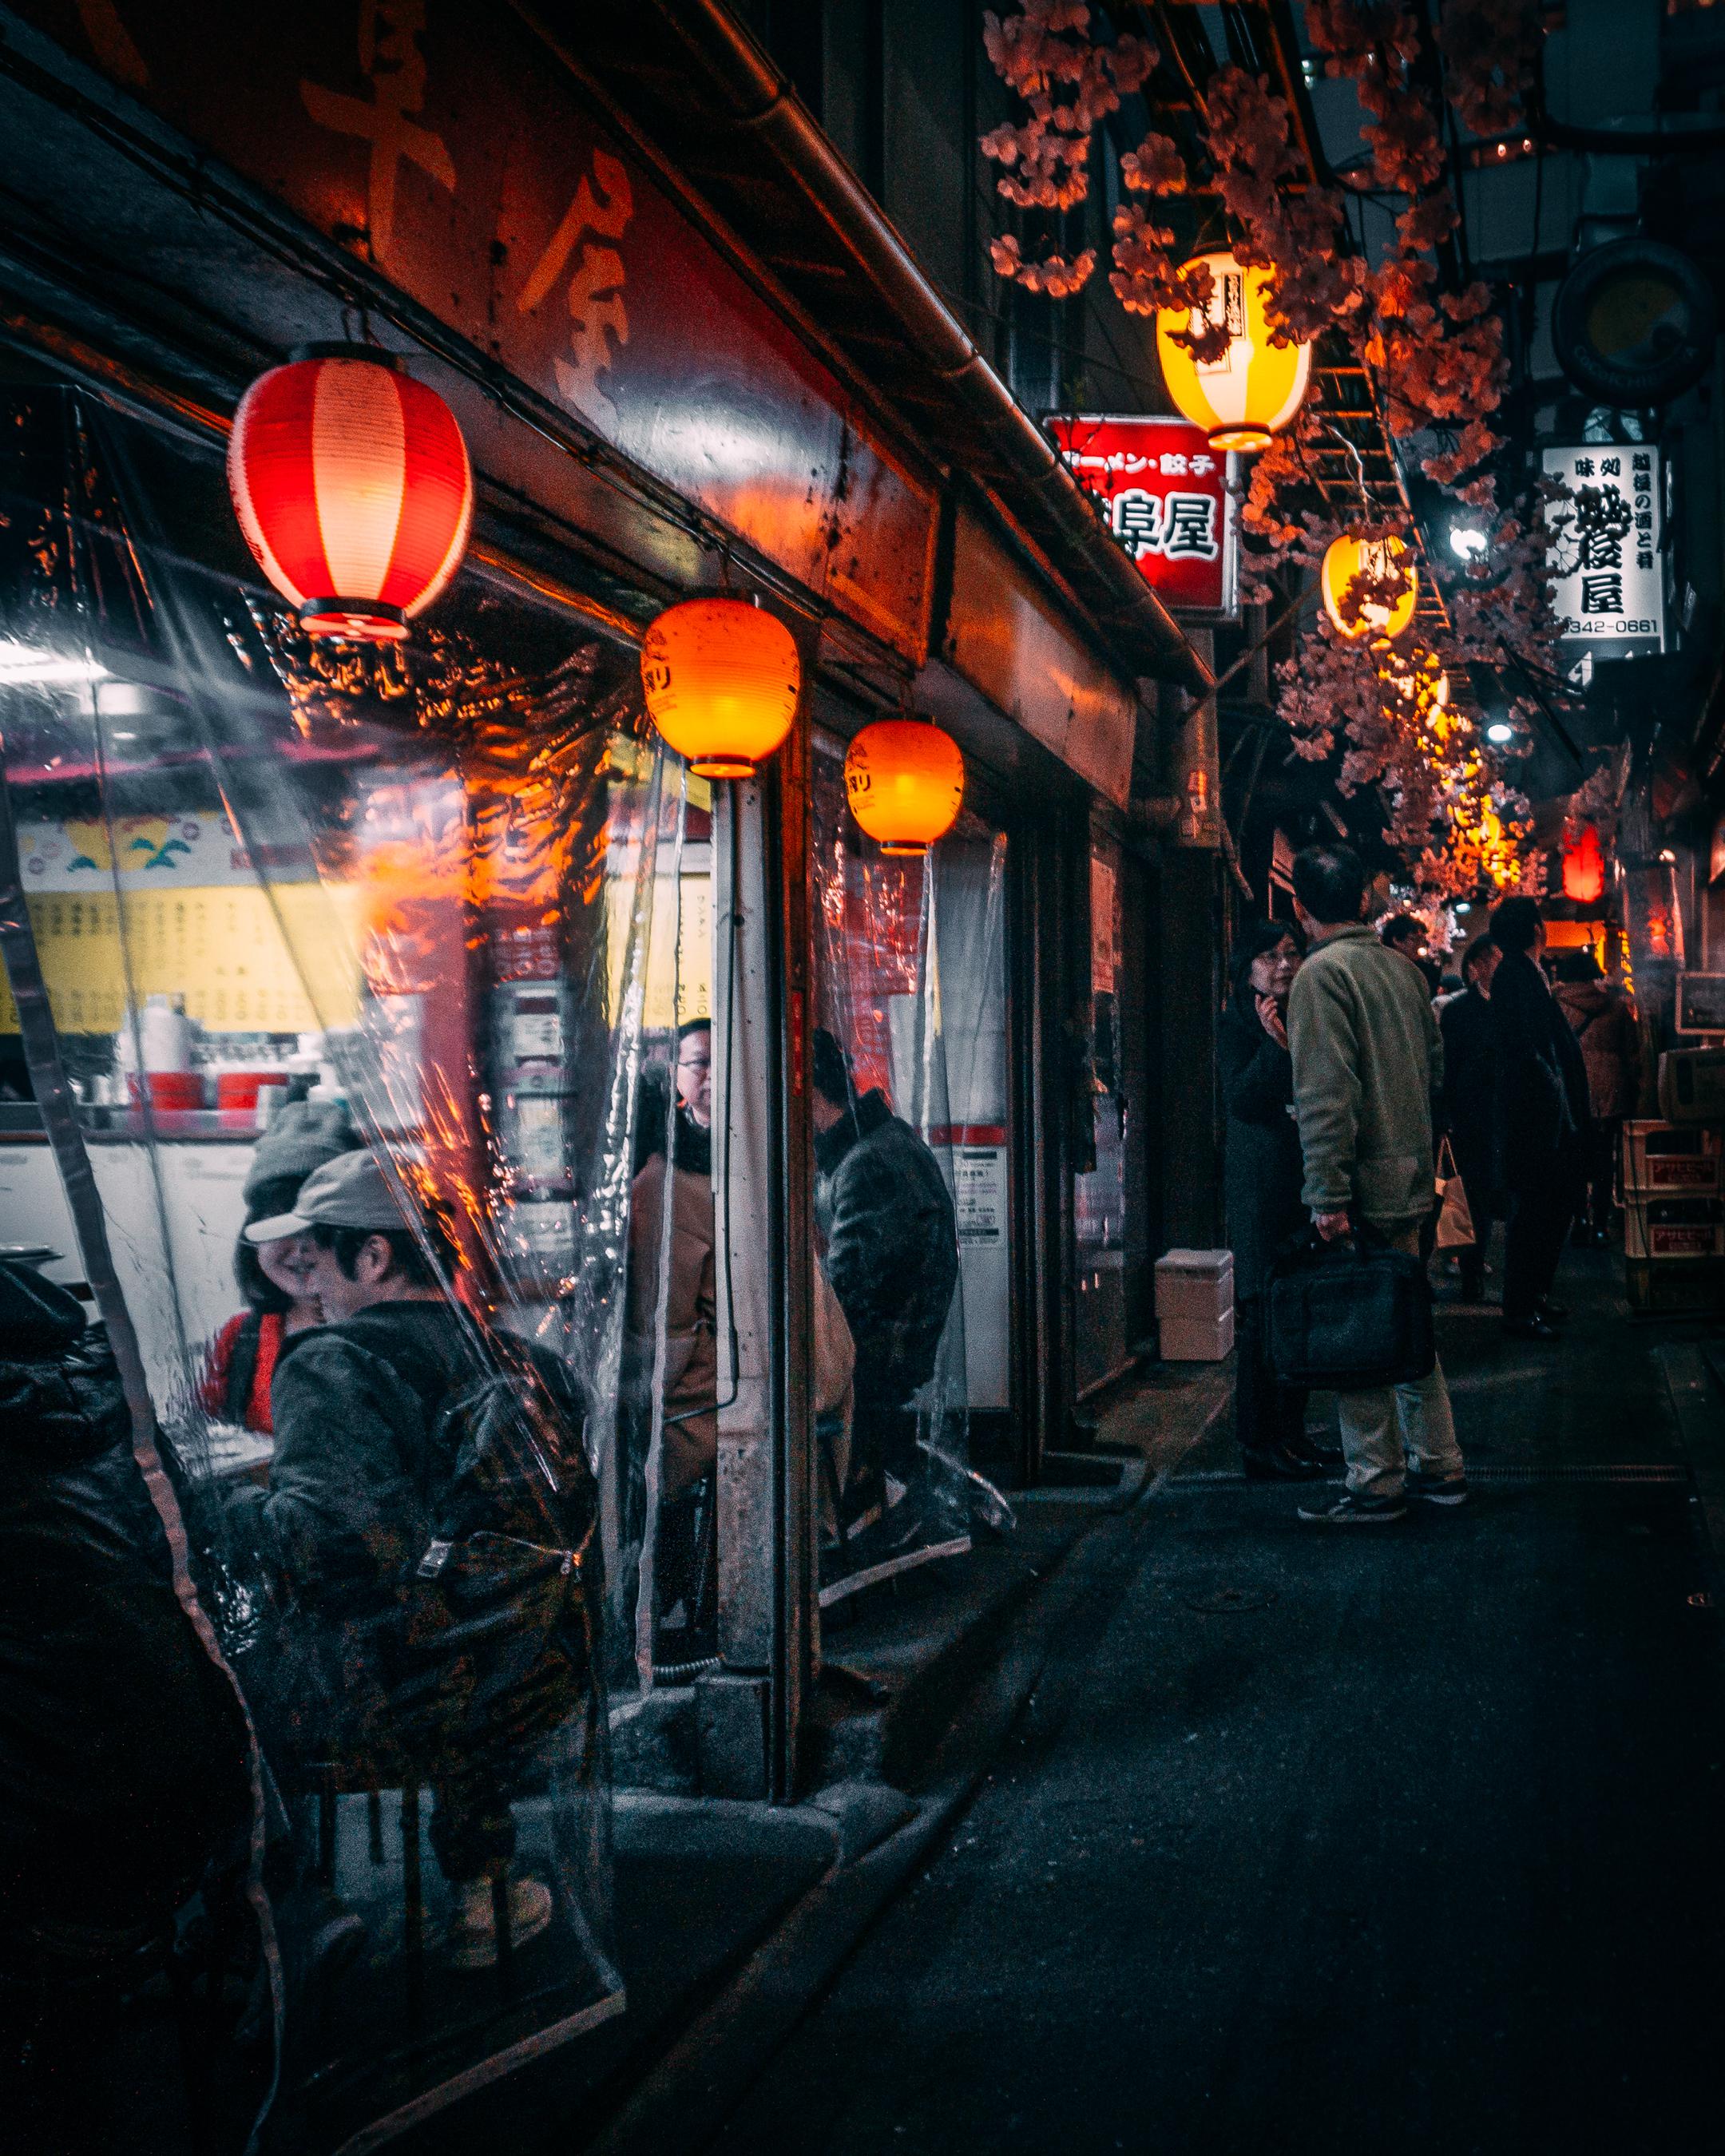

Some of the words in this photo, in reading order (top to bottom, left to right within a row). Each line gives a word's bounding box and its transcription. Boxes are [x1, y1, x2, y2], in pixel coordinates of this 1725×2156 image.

[1575, 457, 1621, 478] 味処
[1102, 488, 1219, 561] 阜屋
[1564, 620, 1658, 633] 342-0661
